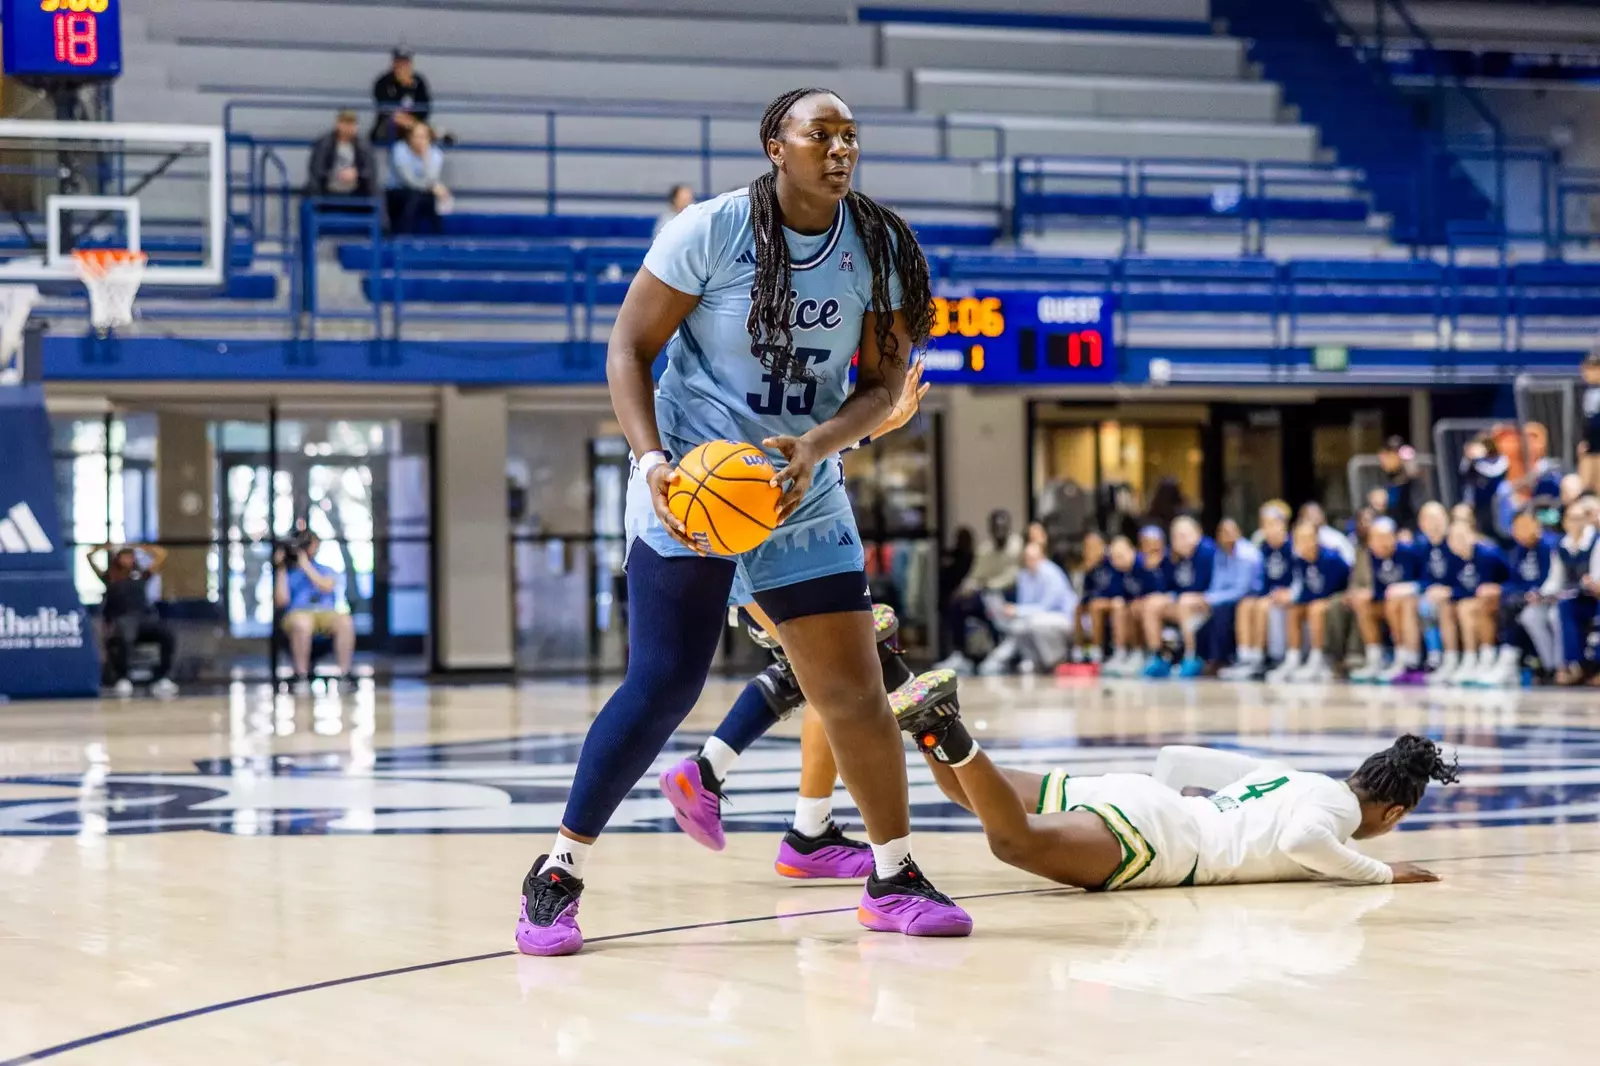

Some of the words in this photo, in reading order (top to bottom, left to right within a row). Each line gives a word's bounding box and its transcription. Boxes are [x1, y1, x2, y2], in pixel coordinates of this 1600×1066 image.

[54, 12, 98, 66] 18
[746, 286, 842, 332] ice
[746, 346, 831, 416] 35
[1238, 776, 1290, 802] 4
